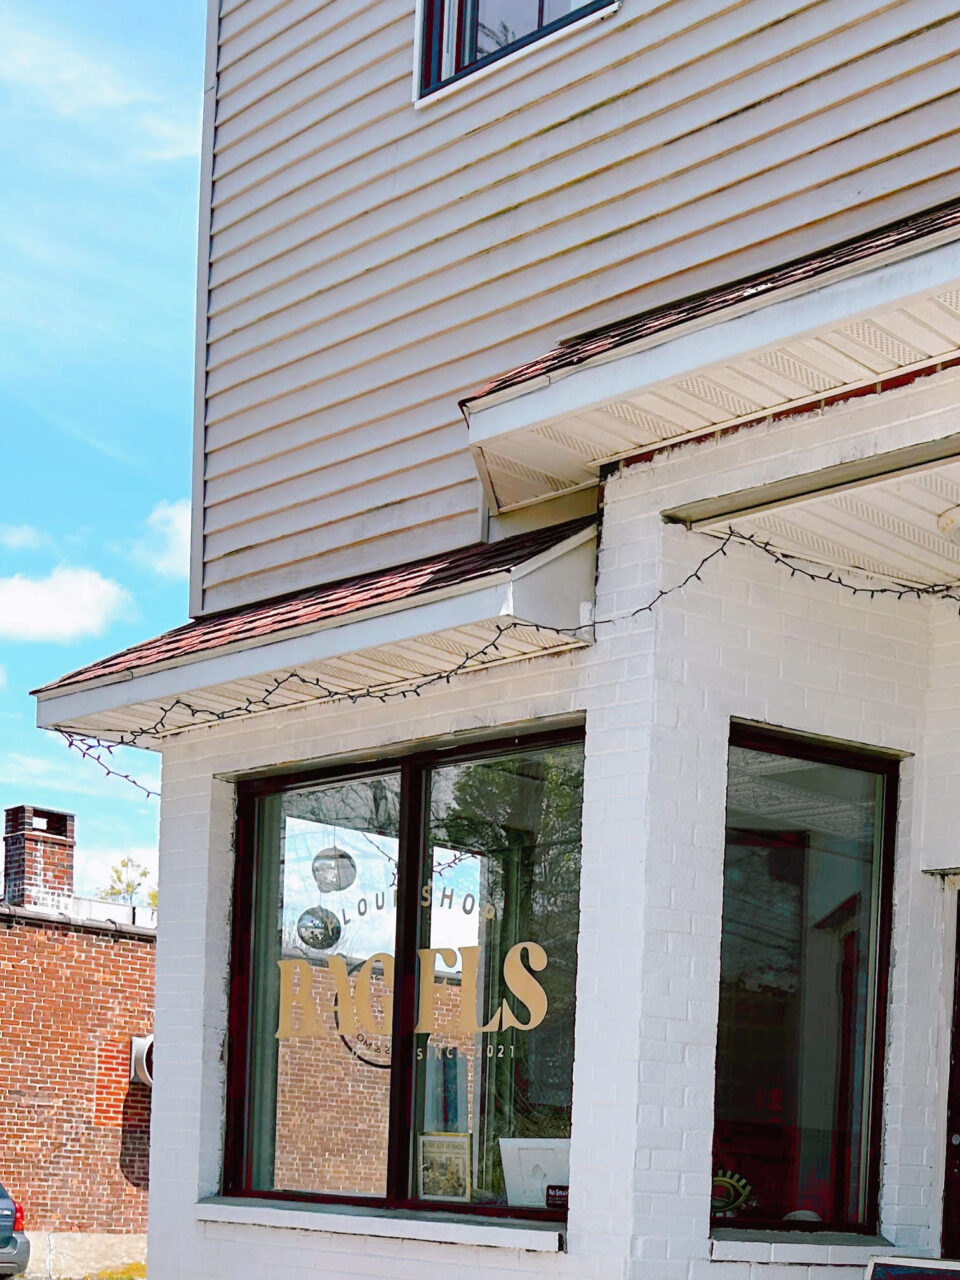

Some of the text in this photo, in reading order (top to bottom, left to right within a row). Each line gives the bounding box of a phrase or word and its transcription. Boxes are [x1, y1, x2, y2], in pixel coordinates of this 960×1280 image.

[326, 884, 496, 937] FLOU SHOP
[416, 1045, 463, 1060] SNC
